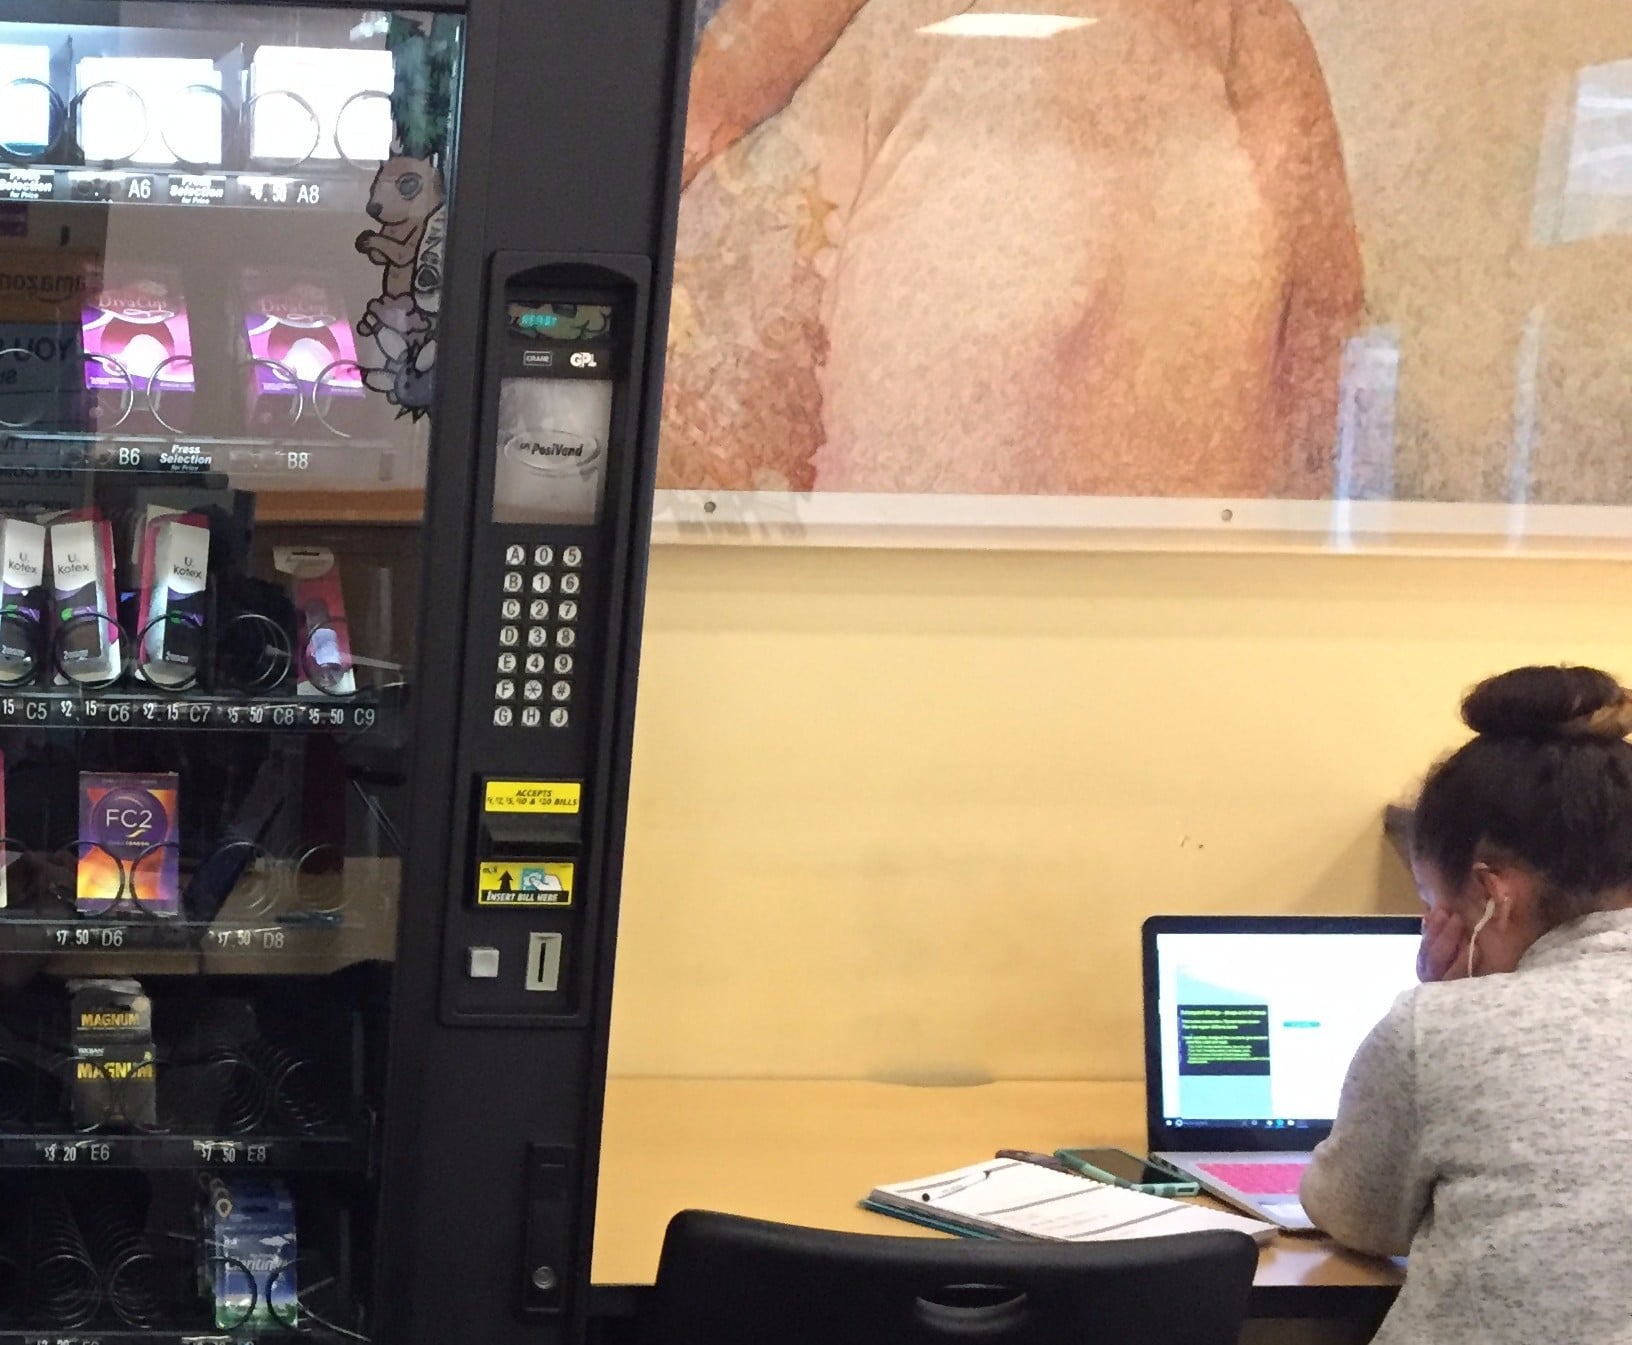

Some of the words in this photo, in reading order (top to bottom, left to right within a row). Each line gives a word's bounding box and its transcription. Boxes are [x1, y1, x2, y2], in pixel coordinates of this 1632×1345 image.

[128, 178, 151, 199] A6
[297, 185, 319, 203] A8
[118, 448, 140, 465] B6
[171, 444, 200, 453] Press
[531, 443, 584, 457] PosiVend
[160, 453, 211, 464] Selection
[288, 452, 308, 469] B8
[511, 547, 520, 561] A
[540, 548, 548, 562] 0
[568, 549, 577, 563] 5
[8, 559, 38, 575] kotex
[57, 562, 89, 575] kotex
[173, 565, 202, 579] kotex
[509, 575, 518, 588] B
[538, 576, 545, 589] 1
[566, 577, 574, 590] 6
[506, 602, 515, 616] C
[535, 603, 544, 616] 2
[564, 604, 573, 617] 7
[505, 629, 514, 642] D
[533, 630, 542, 643] 3
[562, 630, 570, 644] 8
[503, 656, 511, 669] E
[531, 657, 539, 670] 4
[559, 657, 568, 670] 9
[501, 682, 510, 696] F
[26, 702, 47, 720] C5
[108, 703, 130, 722] C6
[190, 704, 209, 722] C7
[273, 708, 294, 725] C8
[354, 709, 375, 725] C9
[499, 709, 508, 723] G
[527, 709, 536, 723] H
[555, 710, 564, 723] J
[516, 789, 552, 797] ACCEPTS
[554, 798, 577, 806] BILLS
[106, 809, 152, 828] FC2
[486, 890, 516, 901] INSERT
[102, 930, 123, 946] D6
[263, 932, 284, 949] D8
[81, 1013, 139, 1027] MAGNUM
[91, 1145, 110, 1161] E6
[248, 1146, 266, 1162] E8
